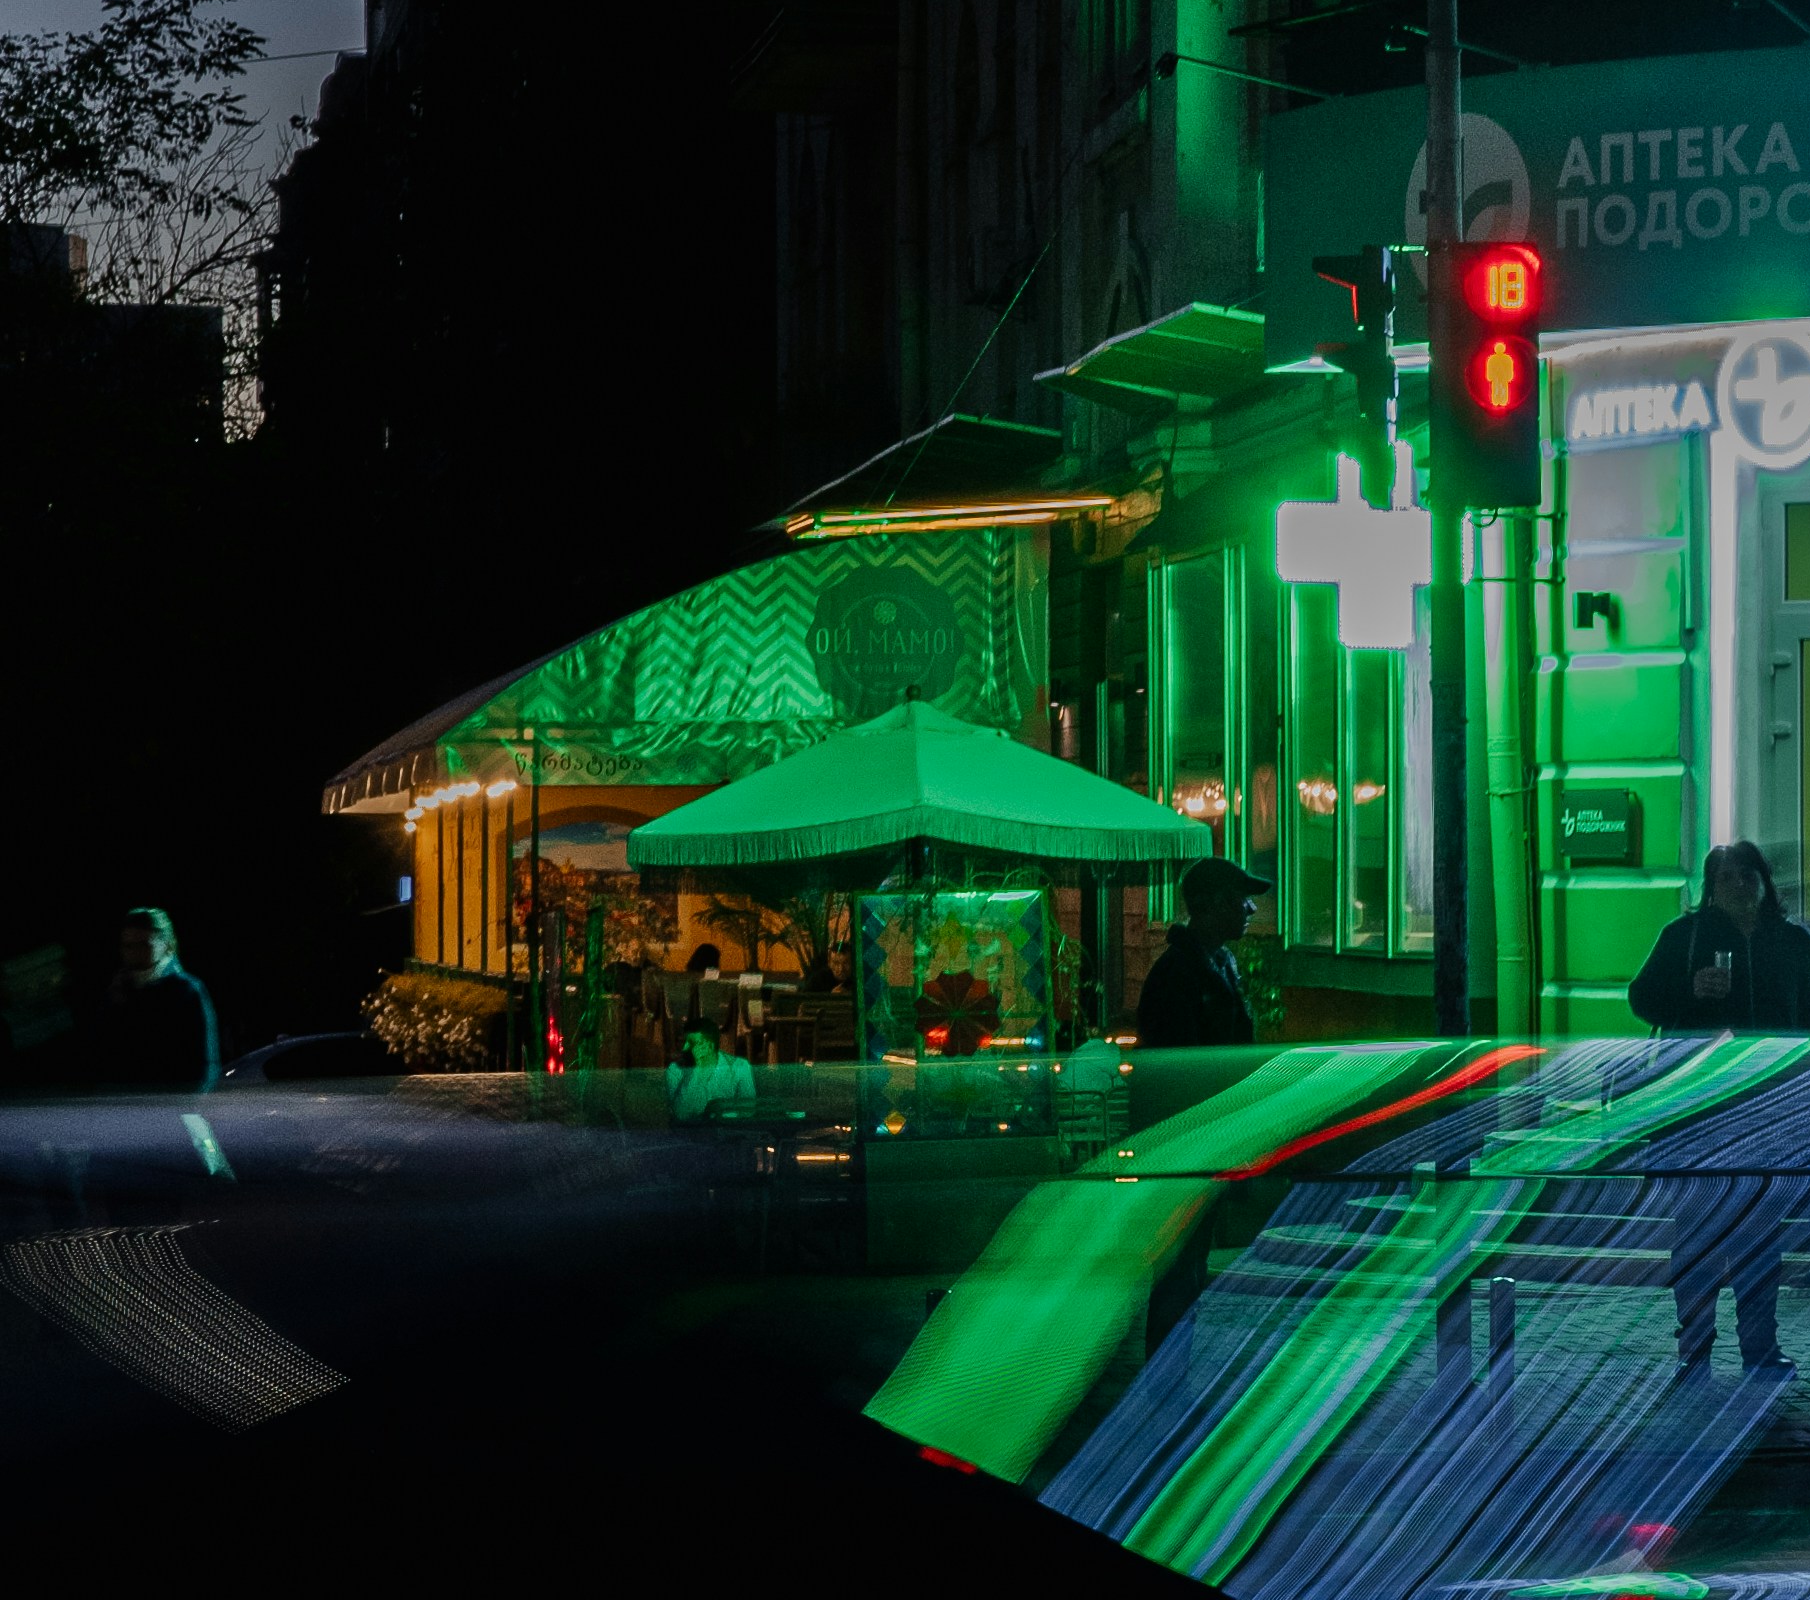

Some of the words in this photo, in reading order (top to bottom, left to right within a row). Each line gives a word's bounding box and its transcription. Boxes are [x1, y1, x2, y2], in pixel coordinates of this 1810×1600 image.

[1557, 120, 1801, 190] АПТЕКА
[1489, 263, 1525, 309] 18
[1571, 383, 1709, 437] АПТЕКА
[514, 751, 644, 778] წრმატება
[1576, 809, 1603, 821] АПТЕКА
